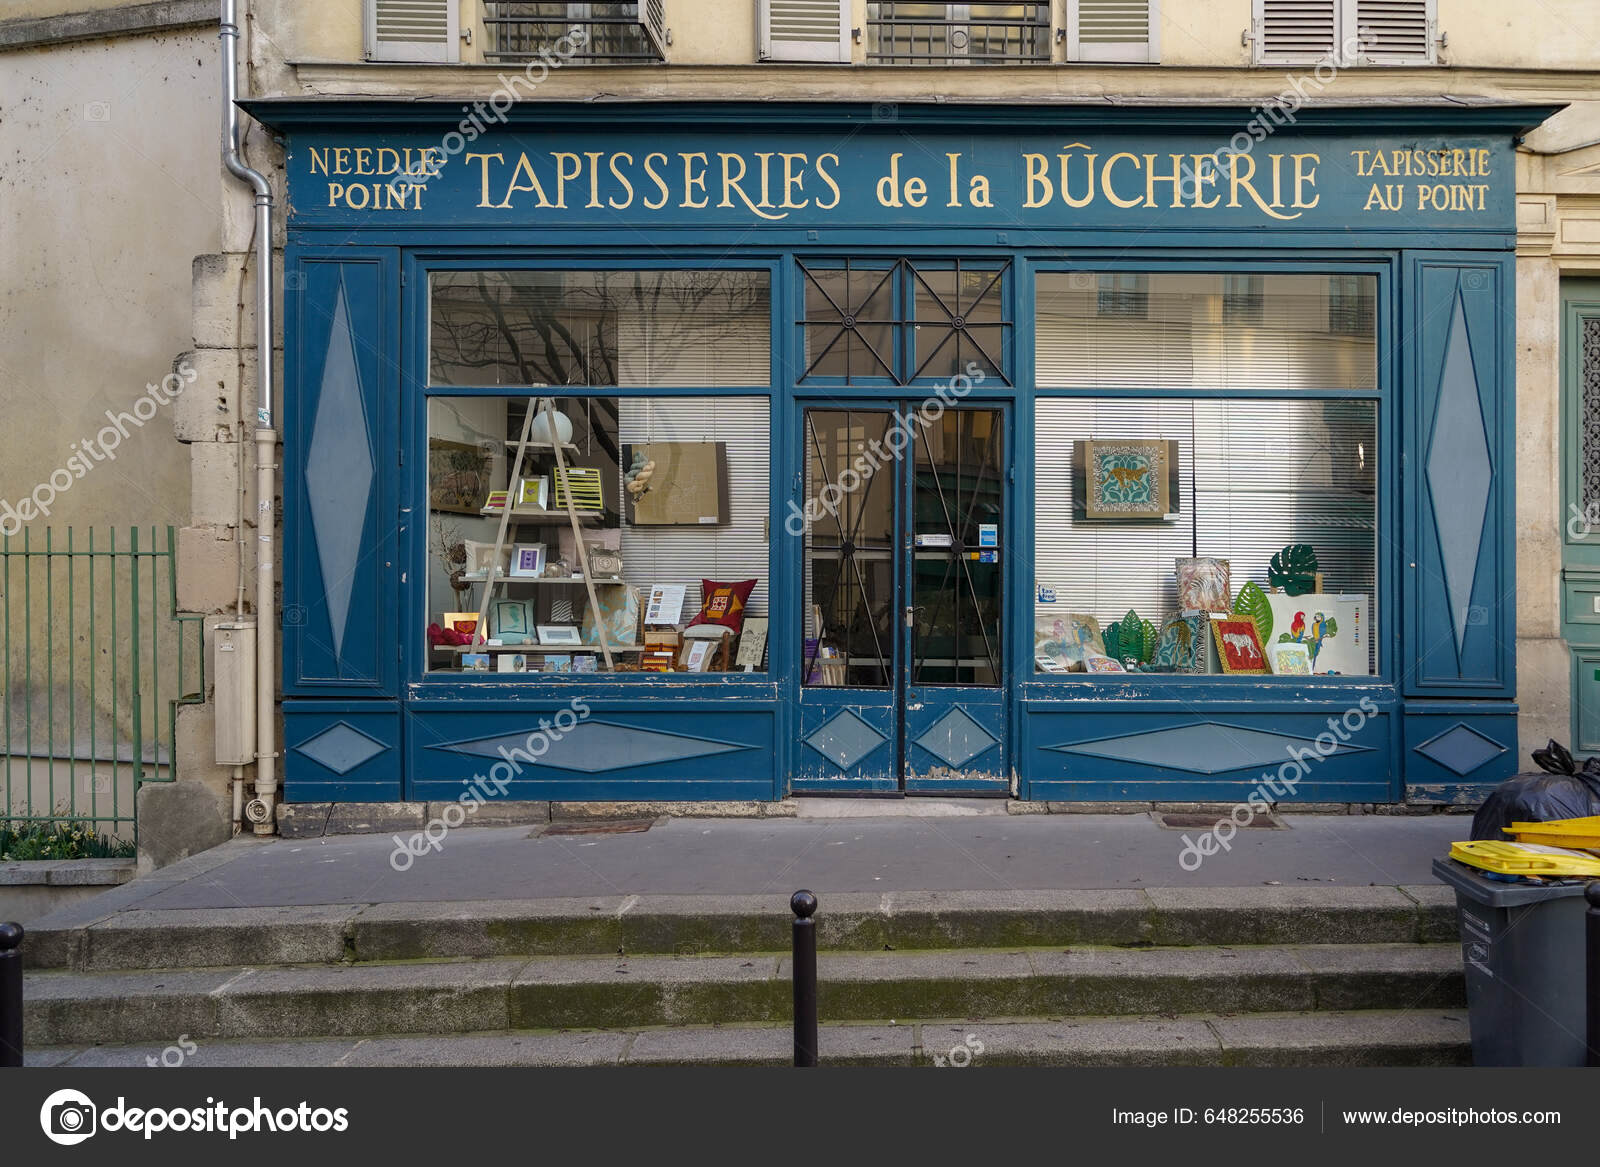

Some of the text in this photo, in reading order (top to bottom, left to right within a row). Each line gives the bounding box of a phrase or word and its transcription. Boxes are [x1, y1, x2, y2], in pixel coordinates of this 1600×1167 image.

[1350, 148, 1492, 177] TAPISSERIE
[465, 142, 1321, 220] TAPISSERIES de la BÛCHERIE
[328, 182, 427, 210] POINT
[1363, 183, 1490, 211] AU POINT
